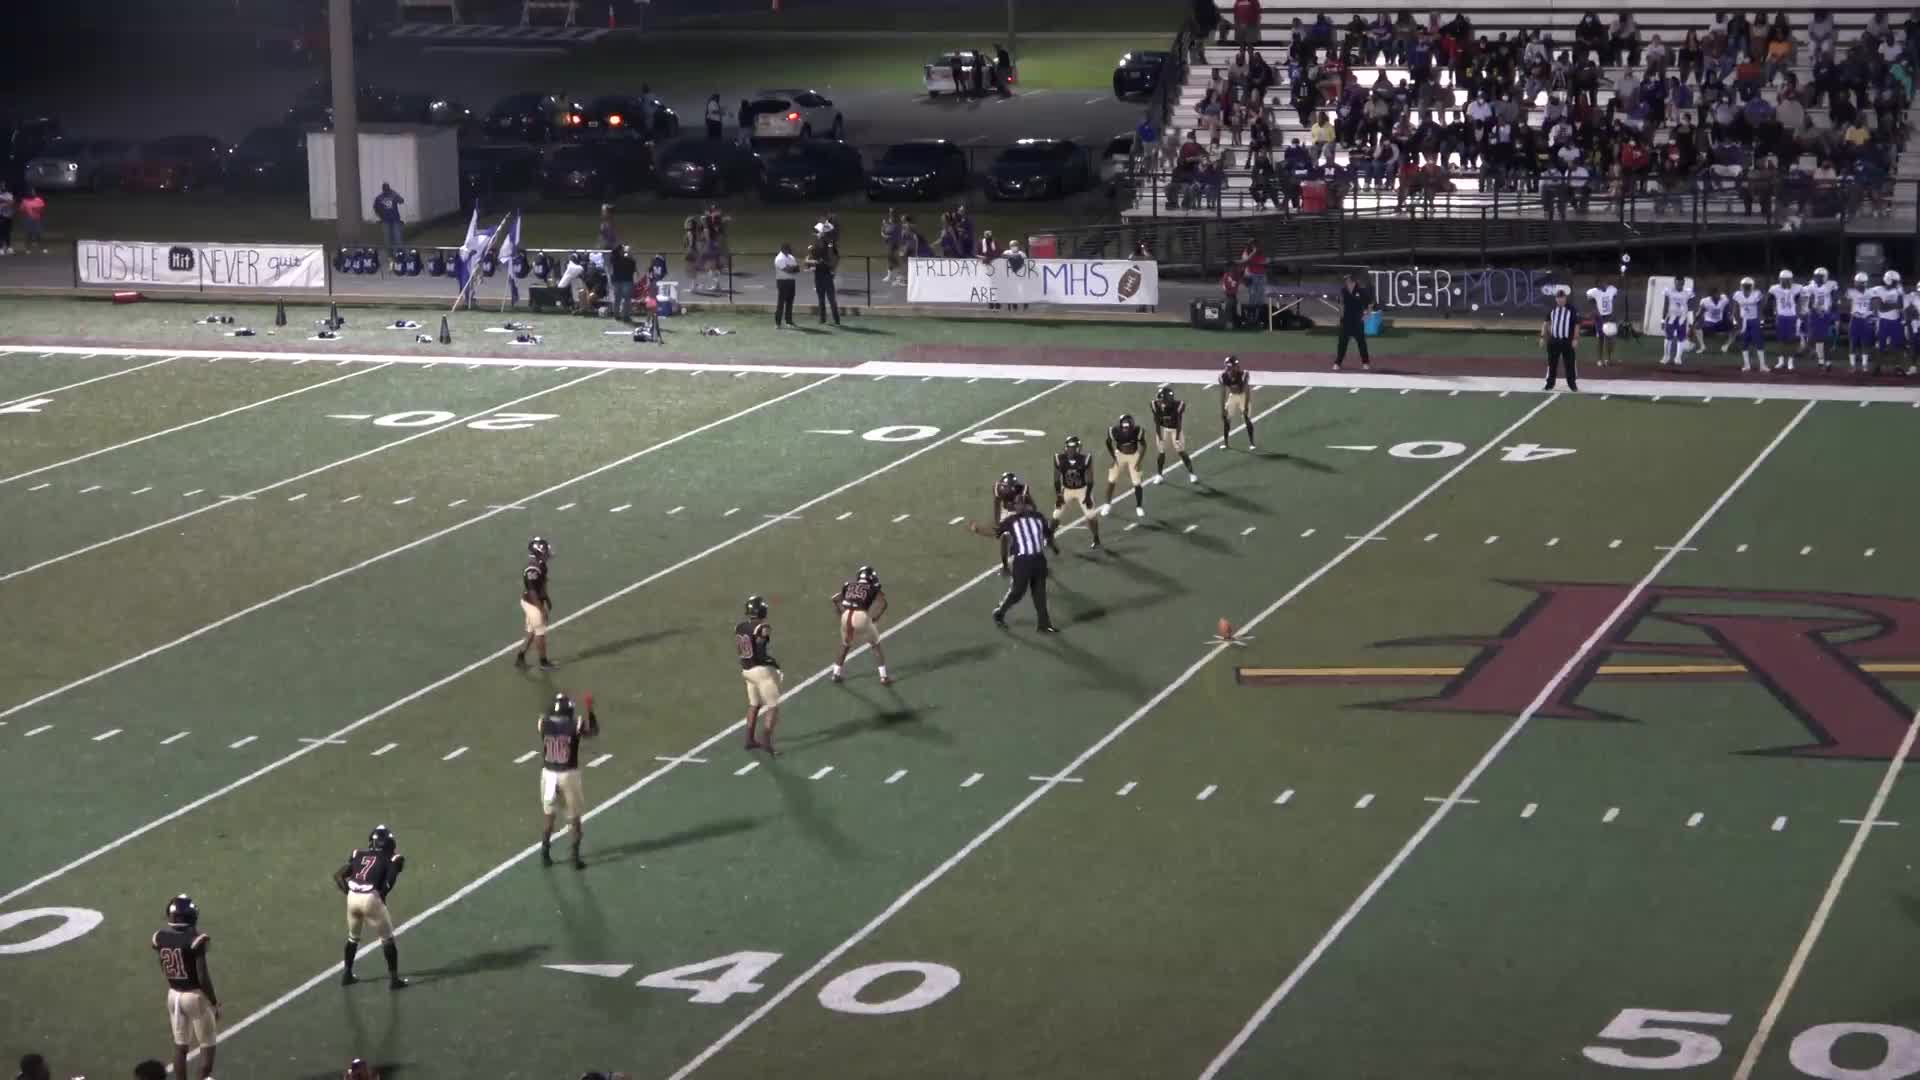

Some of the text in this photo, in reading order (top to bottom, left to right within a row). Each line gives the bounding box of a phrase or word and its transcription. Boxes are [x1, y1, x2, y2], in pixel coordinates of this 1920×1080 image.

[86, 244, 162, 281] HUSTLE
[172, 252, 193, 269] Hit
[200, 249, 260, 285] NEVER
[1043, 262, 1109, 297] MHS
[970, 286, 998, 303] ARE
[1367, 267, 1545, 308] TIGER MODE
[355, 855, 377, 880] 7
[160, 947, 188, 980] 21
[636, 951, 961, 1014] 40
[1582, 1008, 1920, 1080] 50
